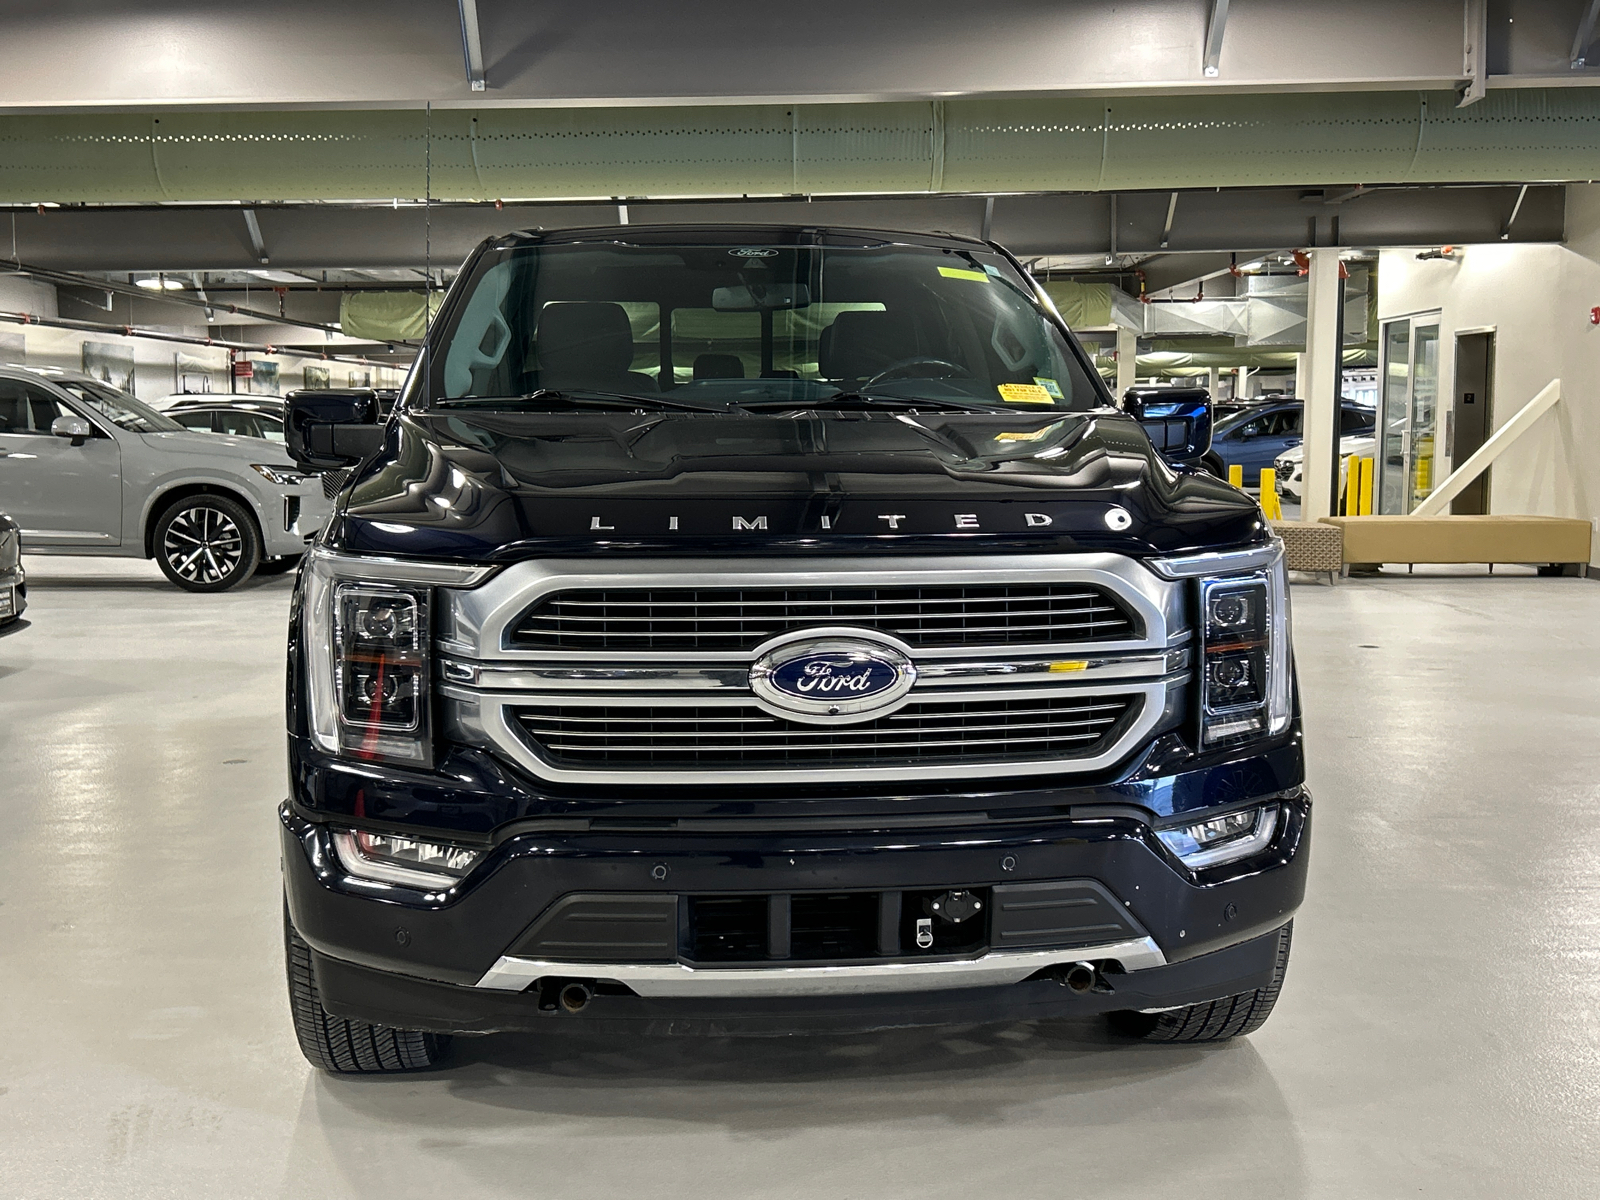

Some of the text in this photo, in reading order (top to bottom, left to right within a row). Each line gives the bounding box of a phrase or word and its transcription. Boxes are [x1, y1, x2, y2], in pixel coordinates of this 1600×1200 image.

[737, 248, 770, 257] Ford
[590, 513, 1053, 530] LIMITED
[796, 660, 873, 692] Ford
